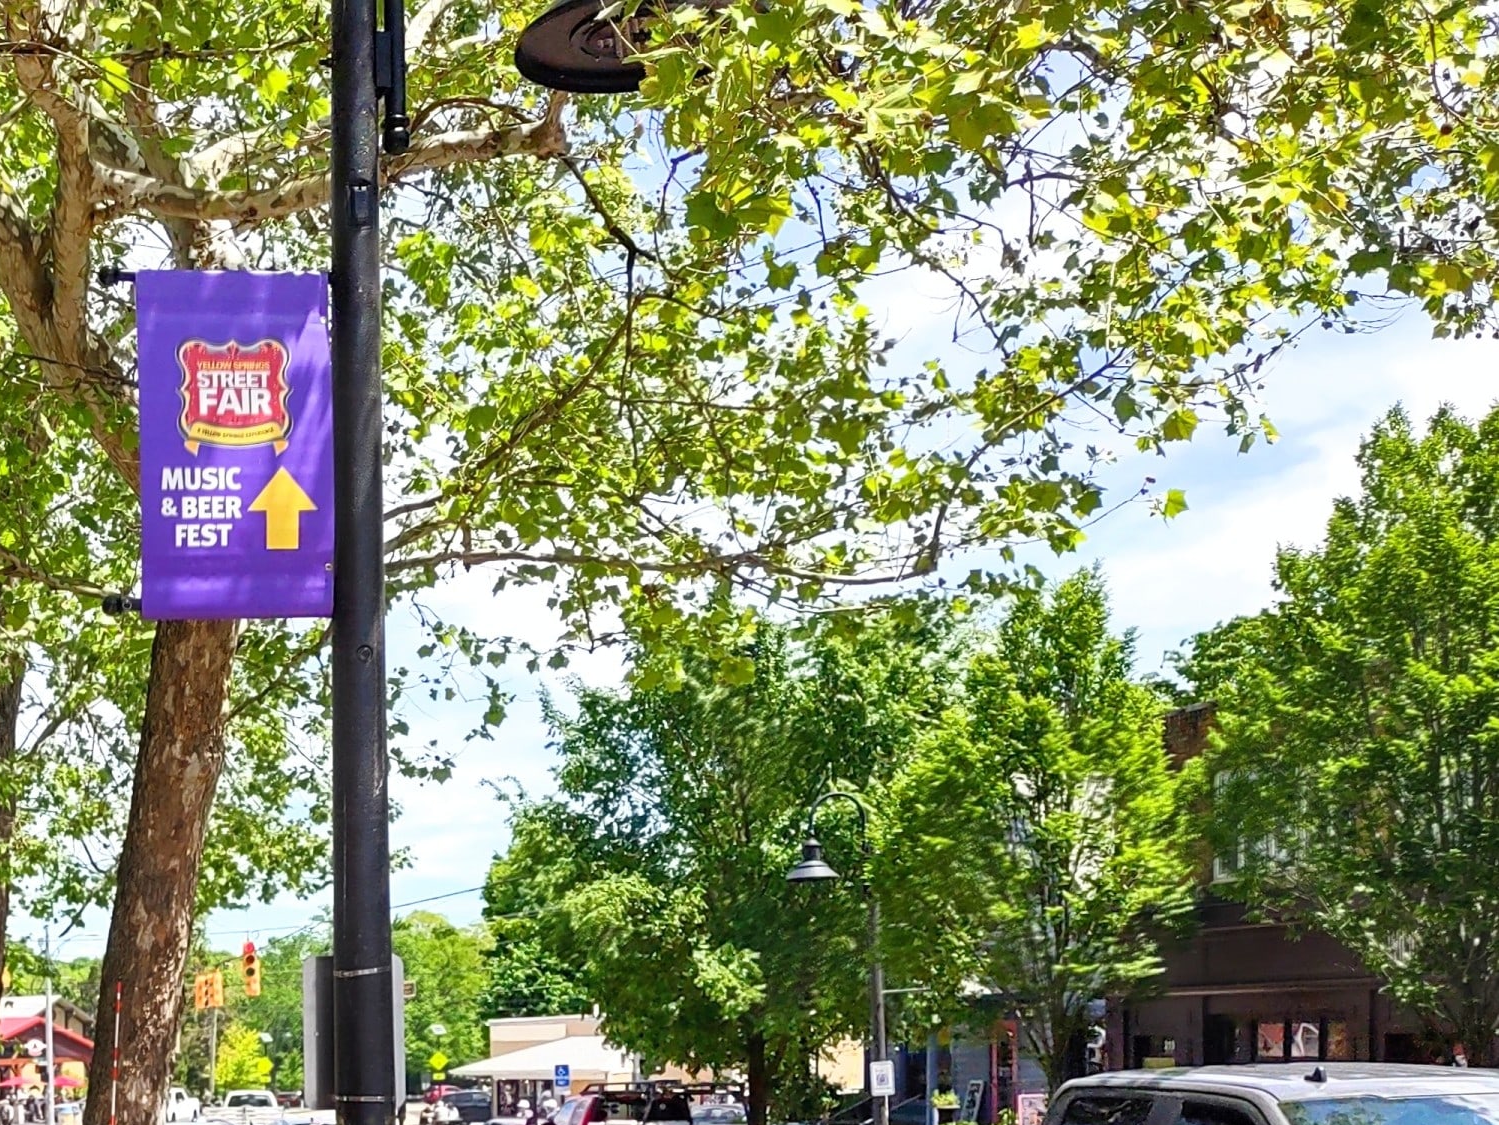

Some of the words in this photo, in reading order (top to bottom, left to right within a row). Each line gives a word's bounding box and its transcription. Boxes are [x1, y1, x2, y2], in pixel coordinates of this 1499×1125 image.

[197, 361, 231, 370] YELLOW
[233, 361, 270, 370] SPRINGS
[197, 370, 271, 388] STREET
[199, 388, 273, 416] FAIR
[161, 466, 241, 491] MUSIC
[161, 496, 178, 518] &
[182, 496, 242, 520] BEER
[175, 523, 232, 548] FEST
